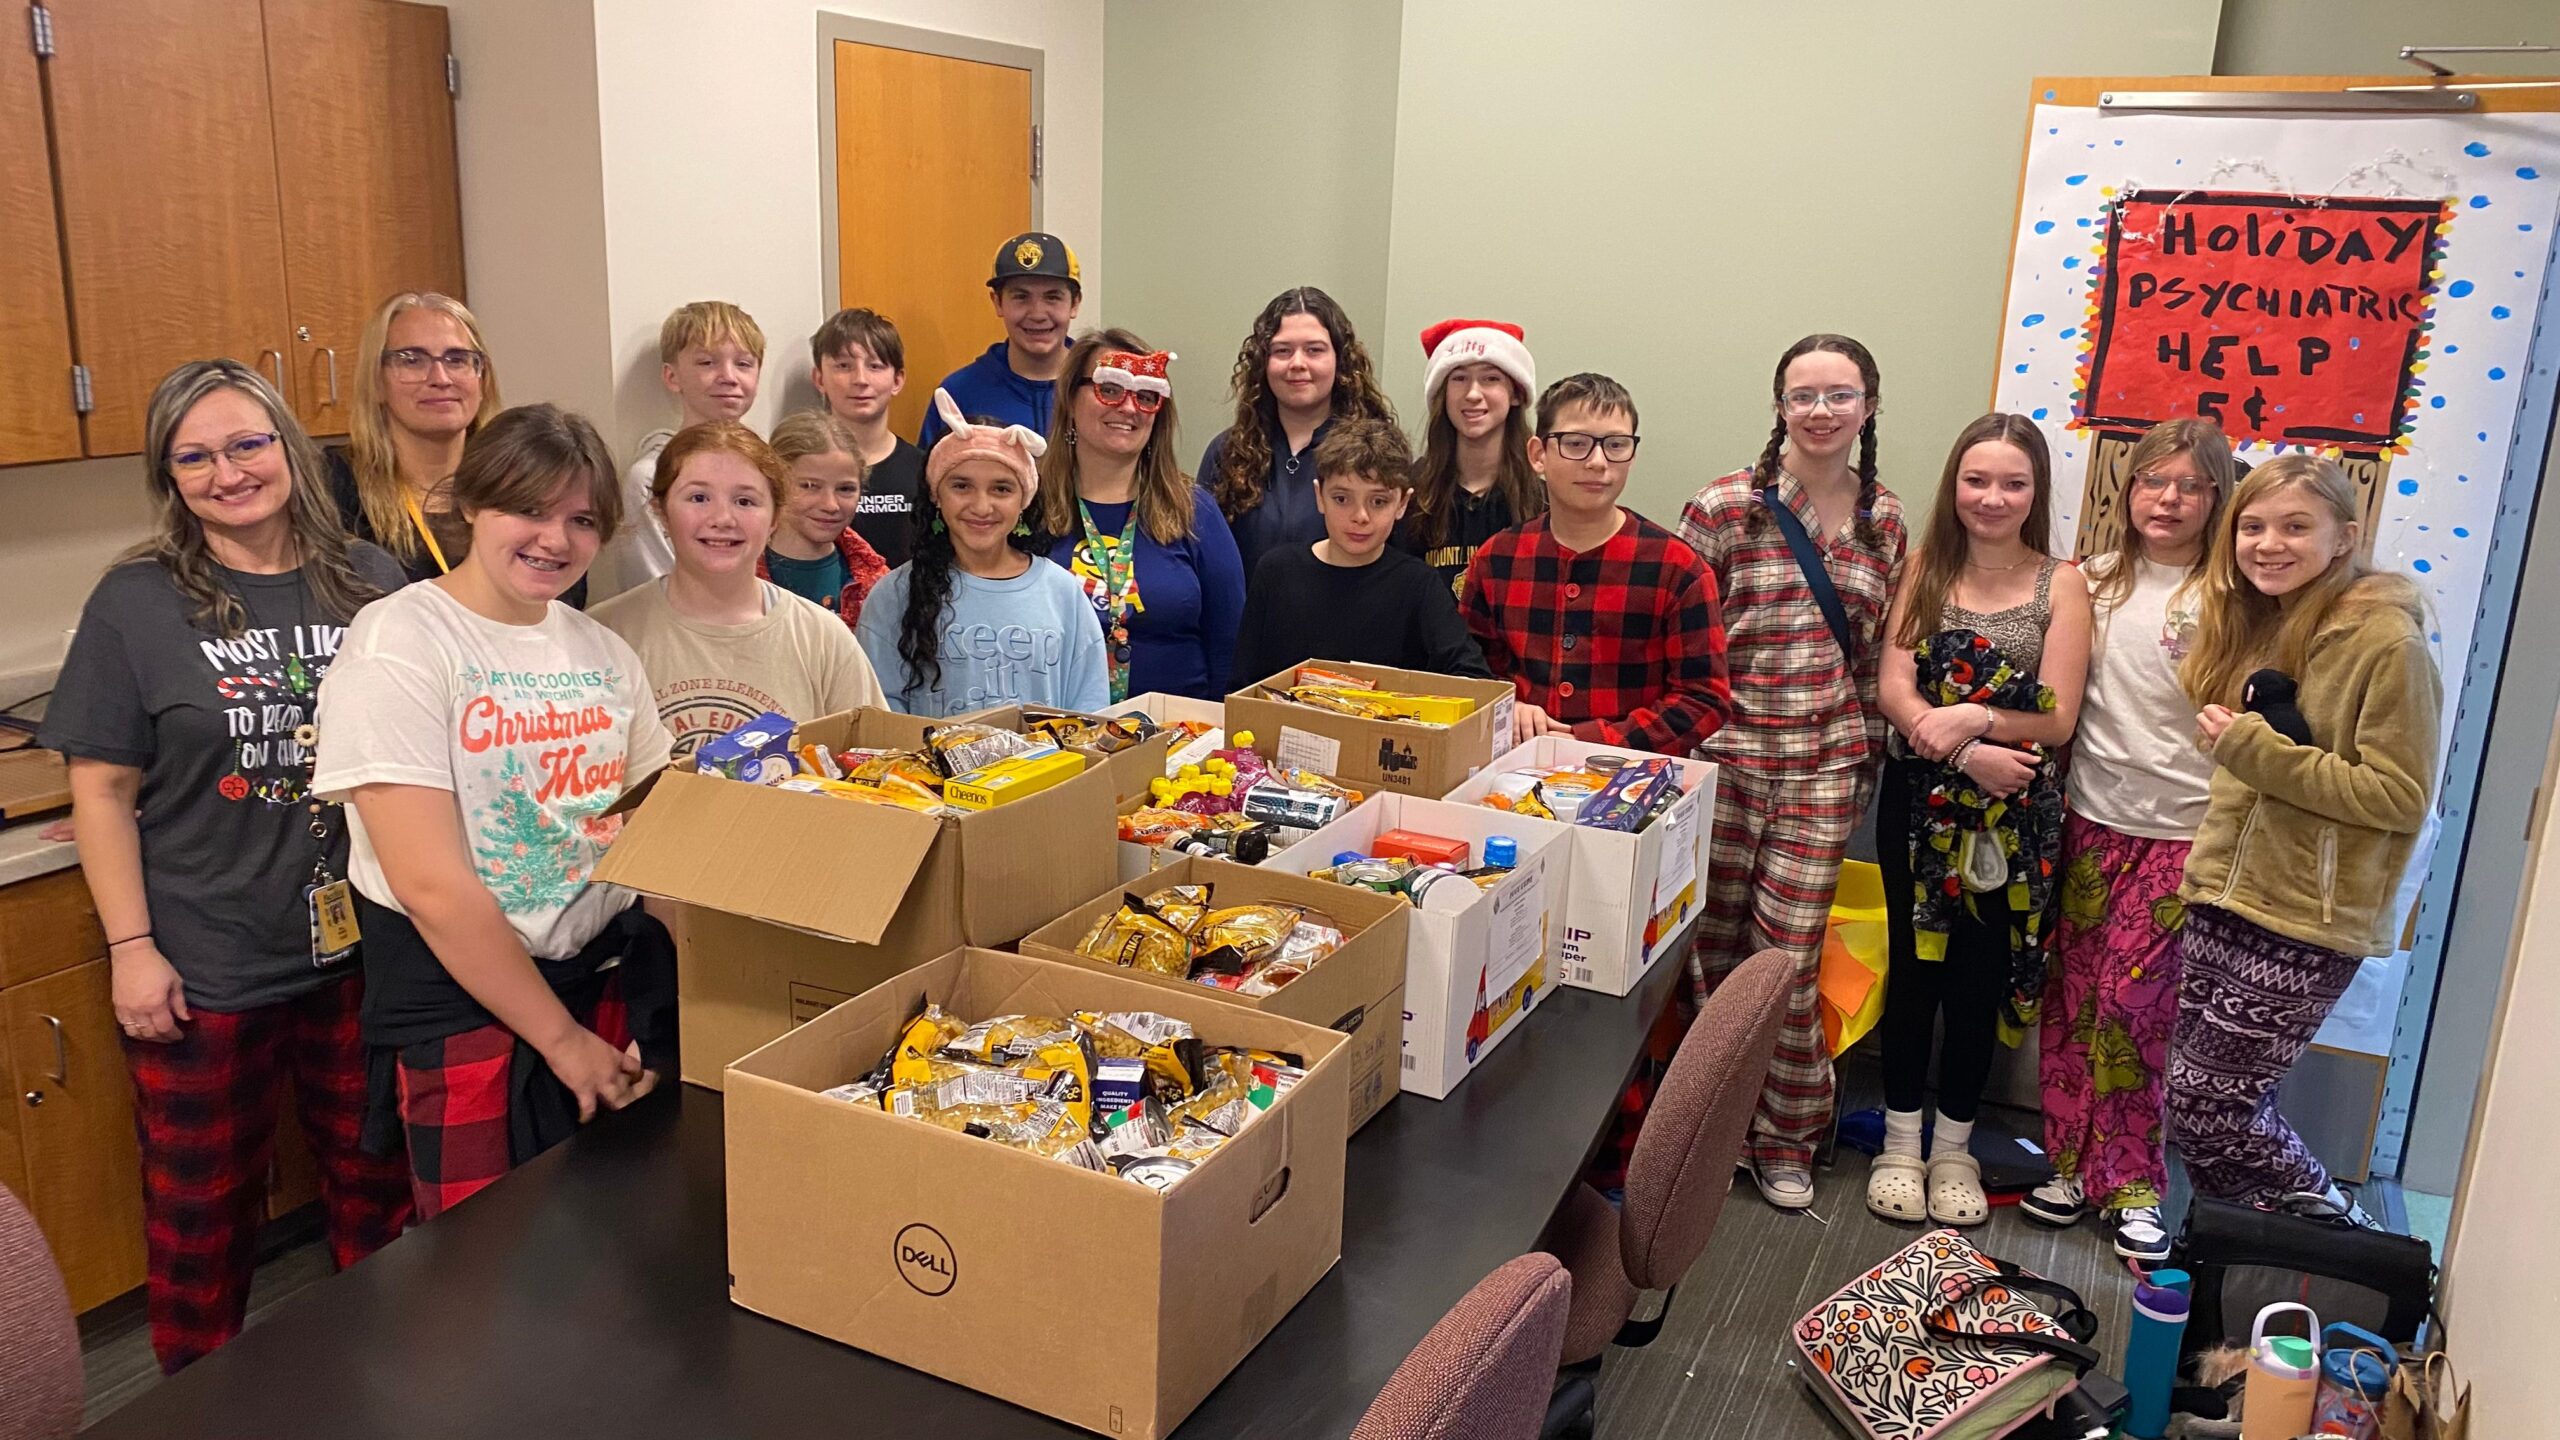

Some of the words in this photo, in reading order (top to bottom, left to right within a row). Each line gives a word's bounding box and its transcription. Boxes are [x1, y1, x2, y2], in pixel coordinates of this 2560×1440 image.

[2128, 272, 2422, 322] PSYCHIATRIC
[2157, 331, 2331, 381] HELP
[199, 628, 280, 672] MOST
[936, 616, 1061, 675] keep
[984, 656, 1019, 699] it
[669, 678, 711, 695] ZONE
[716, 679, 790, 716] ELEMENT
[223, 706, 257, 737] TO
[459, 695, 612, 753] Christmas
[709, 711, 749, 731] EDU
[241, 740, 269, 768] ON
[277, 738, 306, 766] CHR
[949, 785, 987, 804] Cheerios
[1563, 925, 1592, 942] IP
[902, 1245, 951, 1276] DELL
